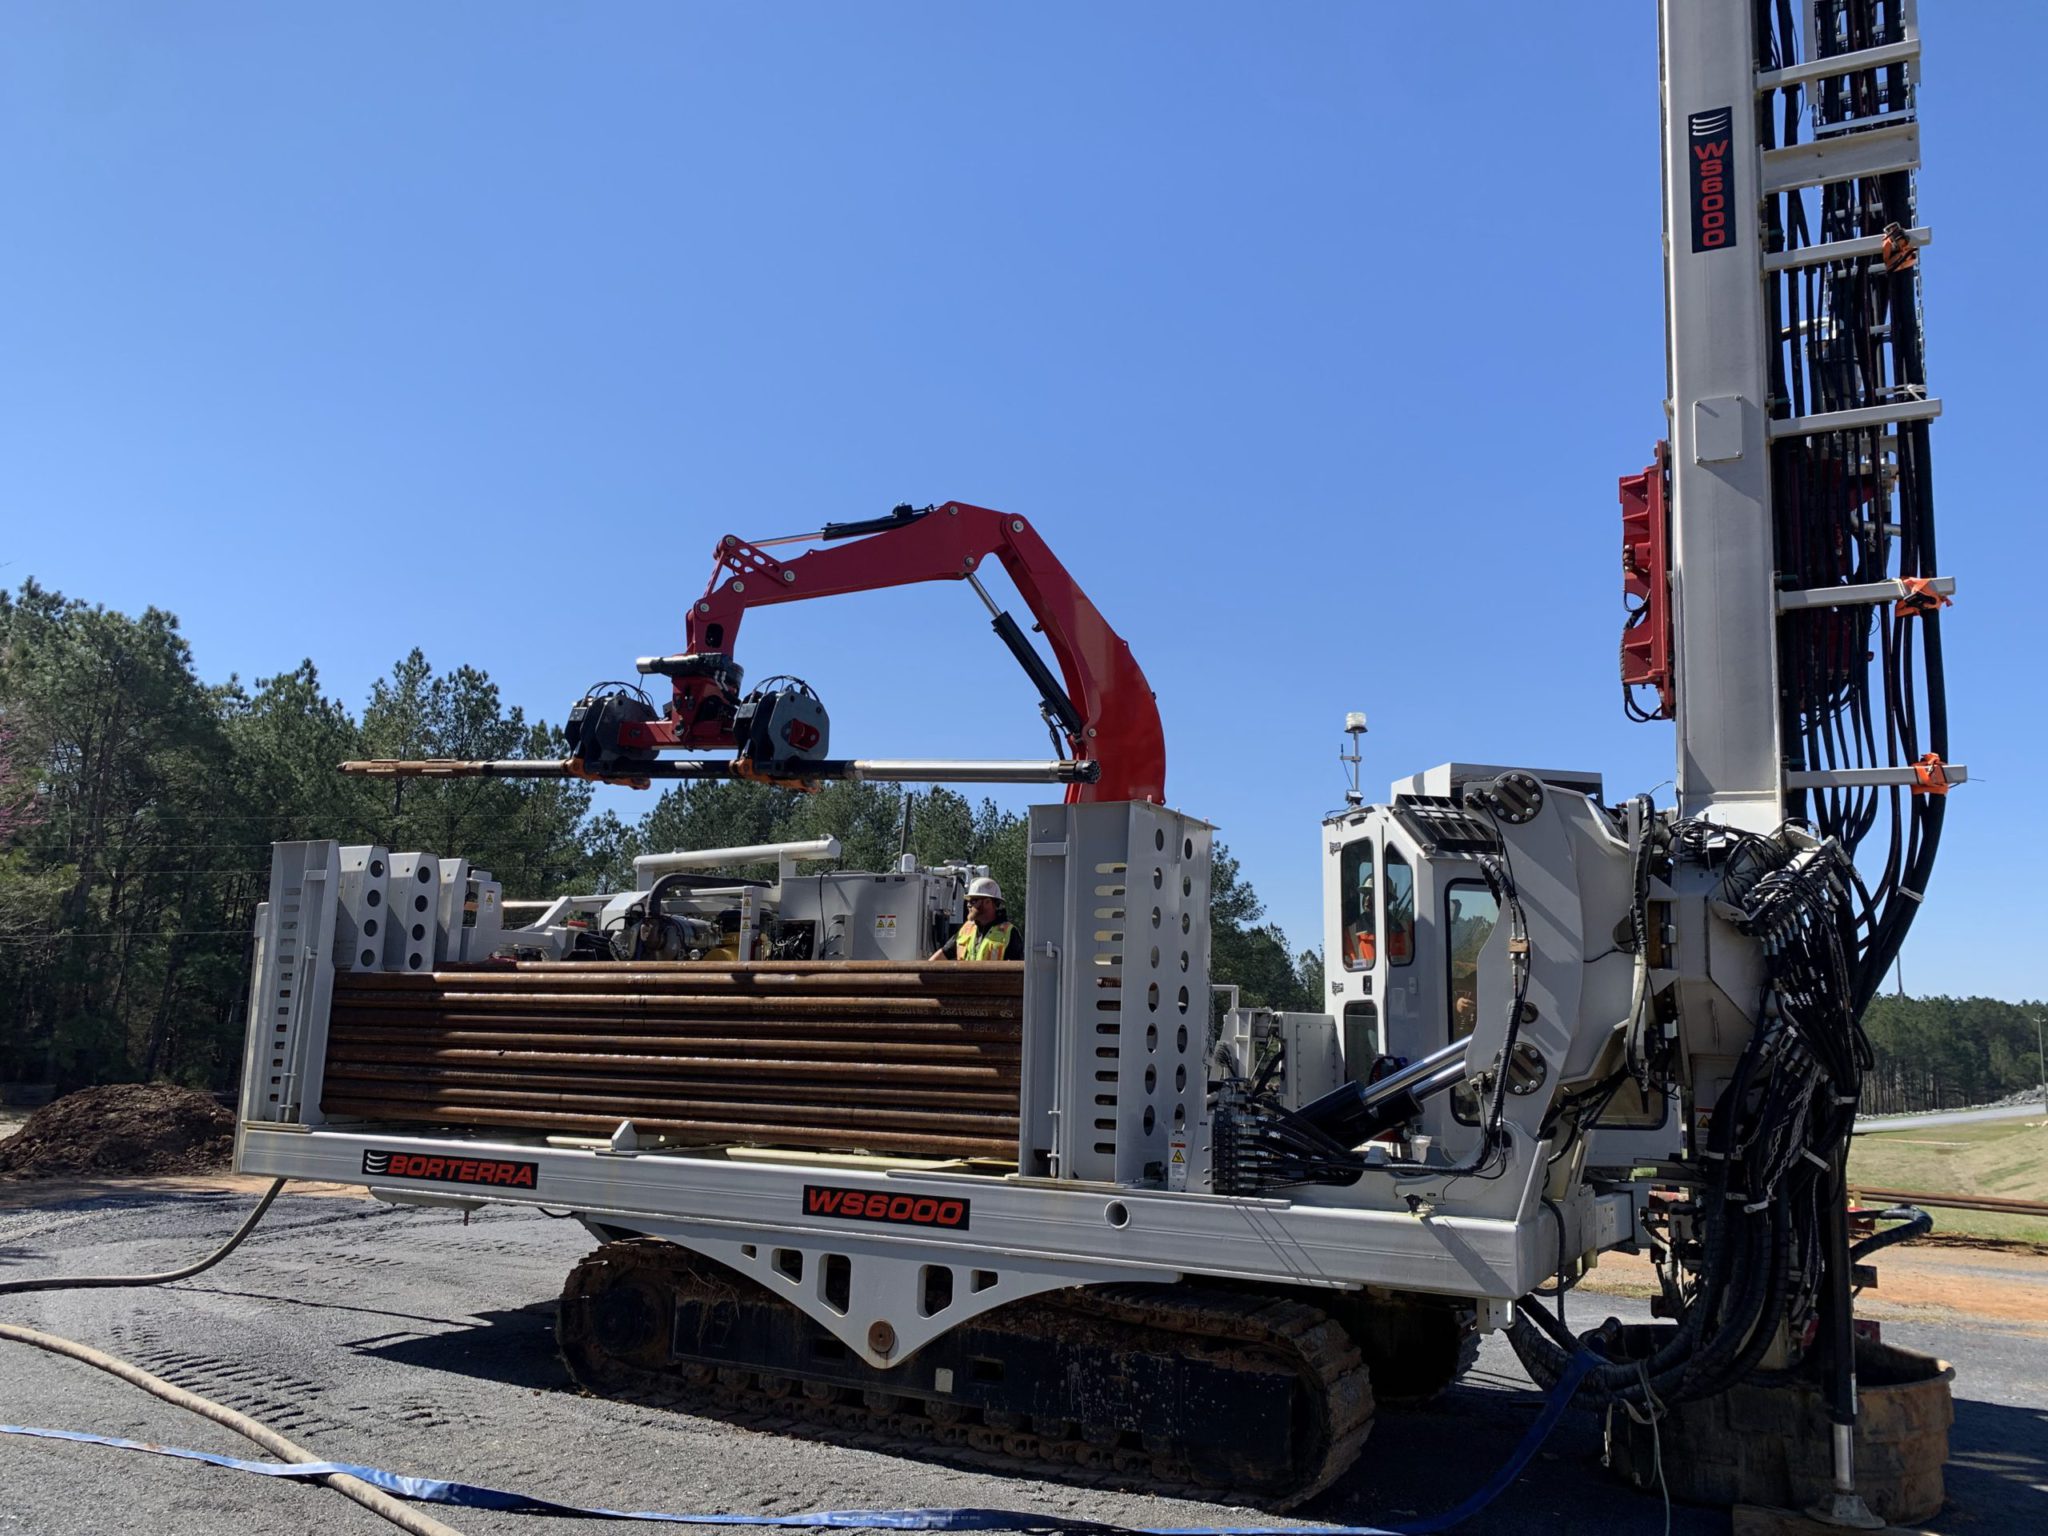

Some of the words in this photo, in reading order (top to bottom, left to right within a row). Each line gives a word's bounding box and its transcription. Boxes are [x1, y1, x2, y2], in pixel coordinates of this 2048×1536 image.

[1694, 139, 1728, 247] WS6000
[388, 1154, 533, 1186] BORTERRA
[809, 1189, 964, 1225] WS6000
